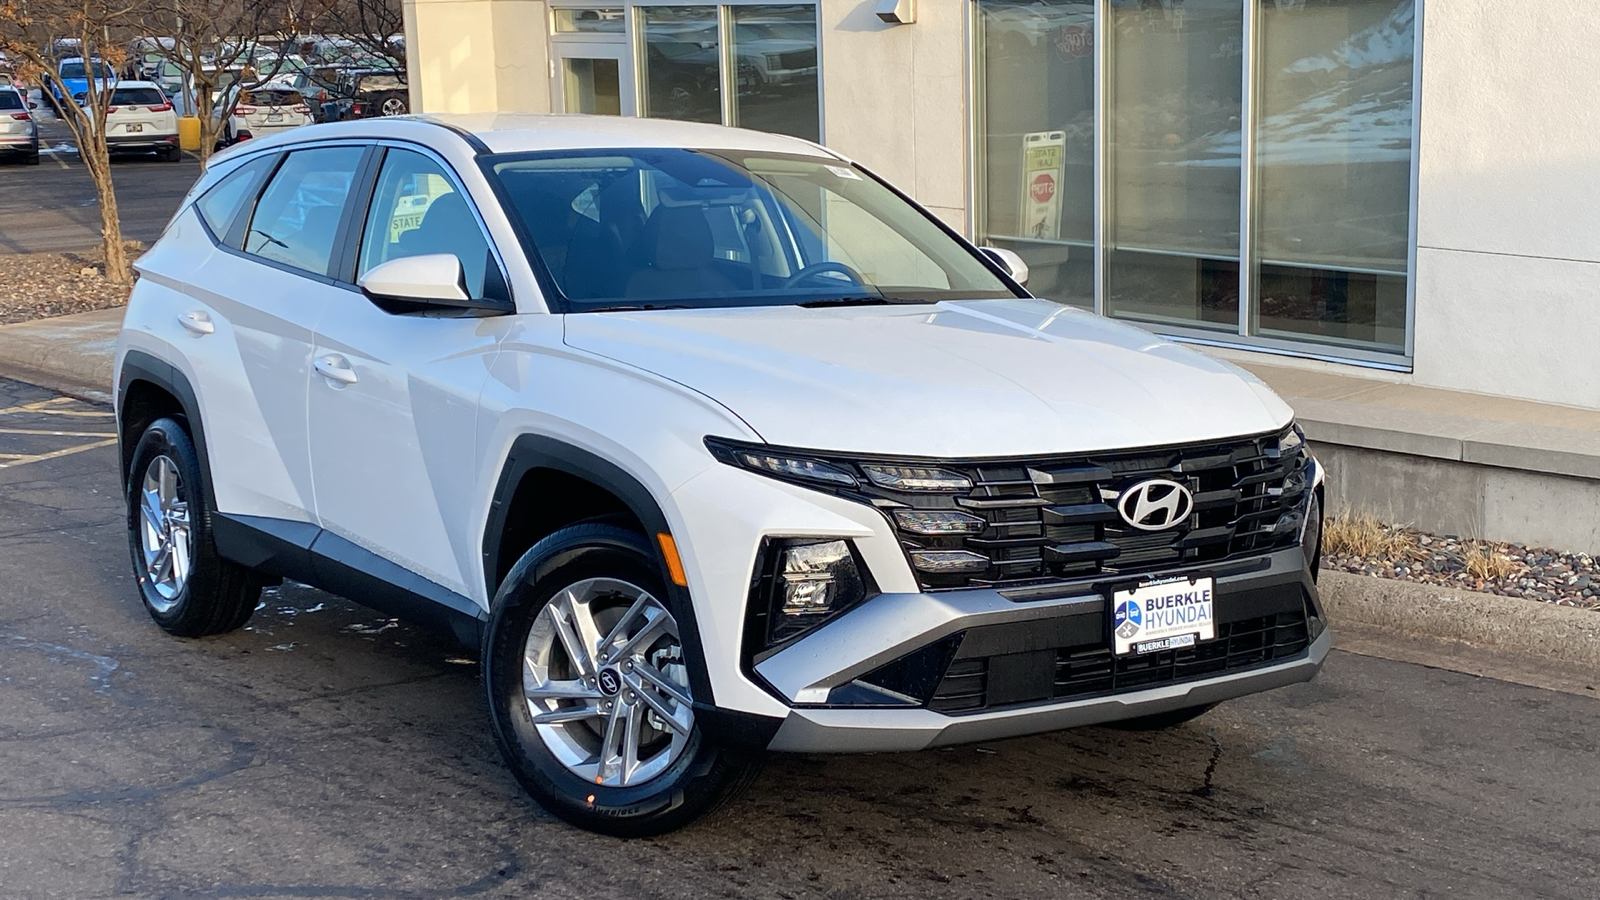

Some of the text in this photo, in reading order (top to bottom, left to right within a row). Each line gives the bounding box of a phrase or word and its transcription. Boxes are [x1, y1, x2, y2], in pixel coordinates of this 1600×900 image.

[393, 216, 420, 229] STATE
[1145, 590, 1211, 612] BUERKLE
[1145, 603, 1211, 630] HYUNDAI
[1138, 639, 1170, 652] BUERKLE
